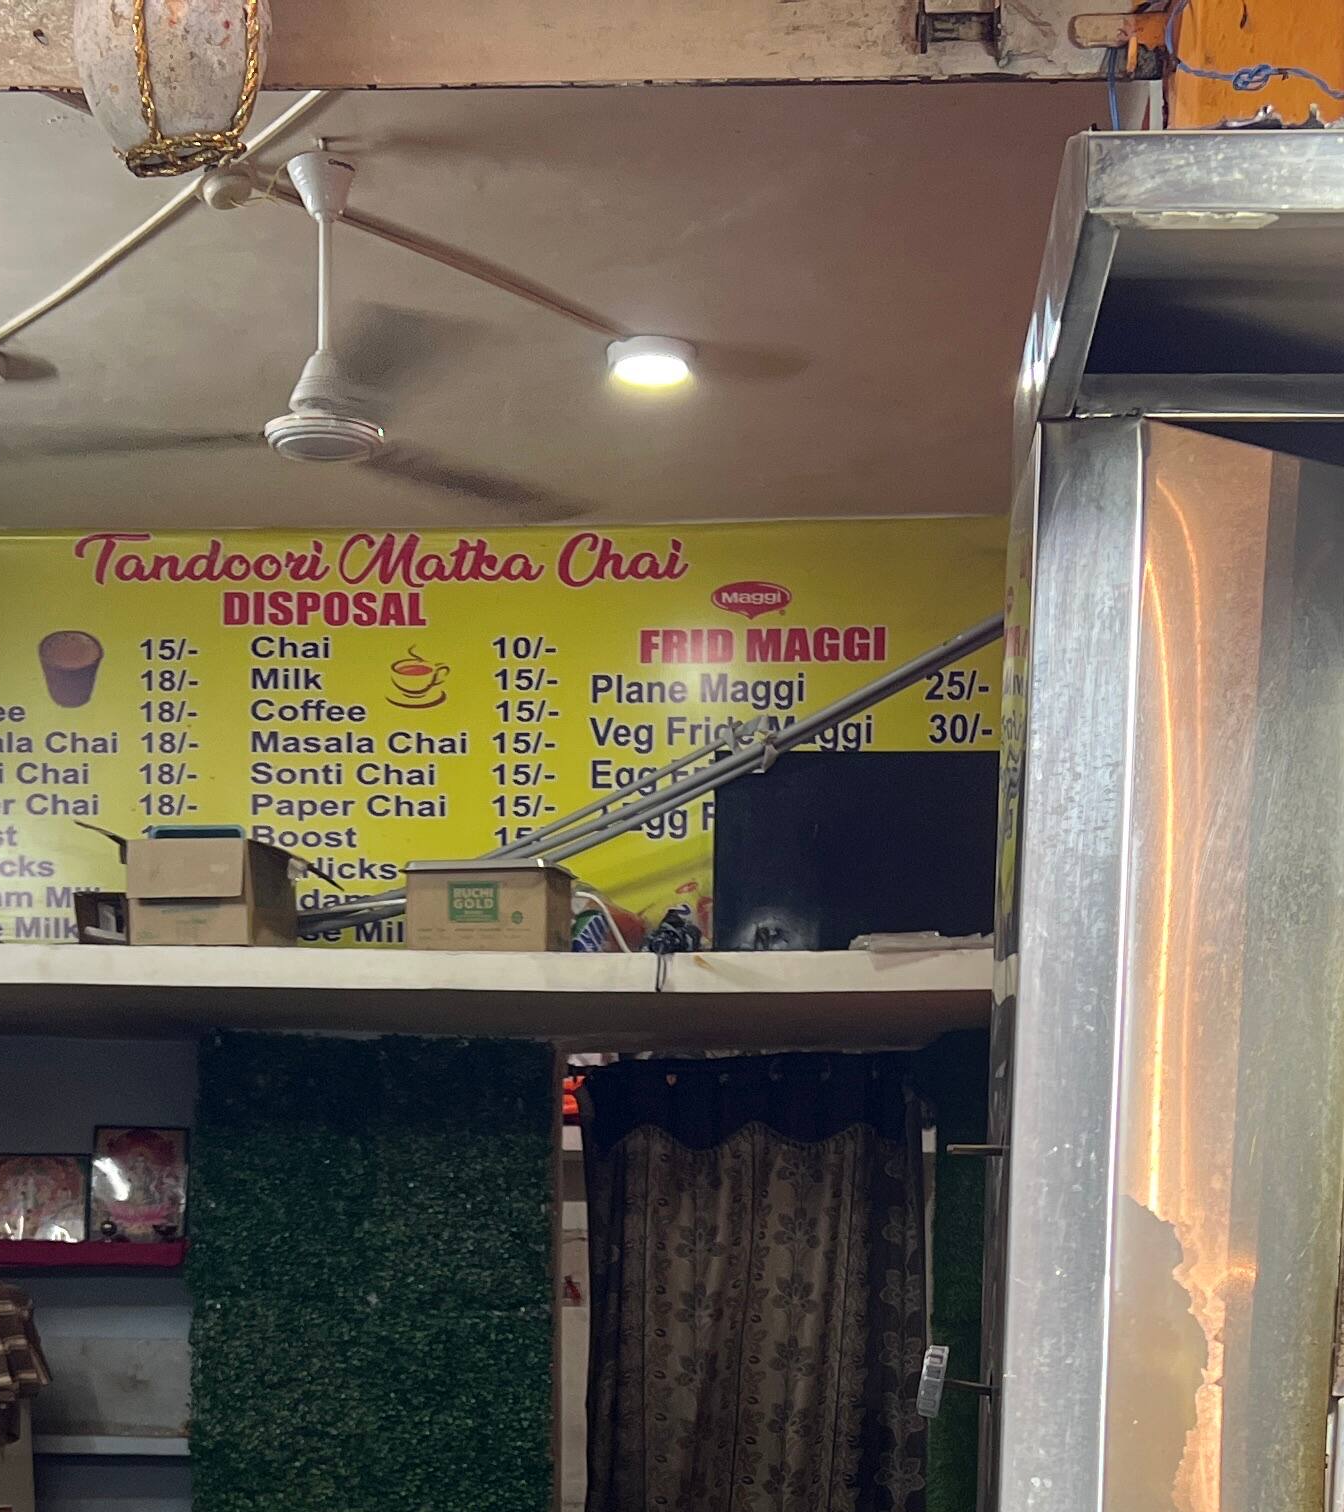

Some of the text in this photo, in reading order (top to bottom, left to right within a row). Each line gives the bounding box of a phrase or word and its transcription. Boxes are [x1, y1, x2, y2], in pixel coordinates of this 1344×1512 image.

[75, 533, 689, 587] Tandoori Matka Chai
[224, 591, 425, 626] DISPOSAL
[720, 589, 783, 608] Maggi
[140, 639, 198, 661] 15/-
[251, 636, 556, 660] Chai 10/-
[641, 627, 886, 664] FRID MAGGI
[141, 670, 198, 692] 18/-
[251, 668, 559, 691] Milk 15/-
[591, 670, 989, 710] Plane Maggi 25/-
[141, 702, 198, 723] 18/-
[251, 700, 560, 723] Coffee 15/-
[45, 732, 118, 754] Chai
[141, 732, 198, 753] 18/-
[251, 732, 556, 754] Masala Chai 15/-
[591, 718, 655, 753] Veg
[929, 713, 993, 745] 30/-
[15, 762, 89, 785] Chai
[140, 763, 197, 785] 18/-
[251, 762, 555, 786] Sonti Chai 15/-
[26, 793, 99, 816] Chai
[140, 795, 197, 815] 18/-
[251, 794, 555, 822] Paper Chai 15/-
[251, 826, 356, 848] Boost
[453, 898, 494, 909] GOLD
